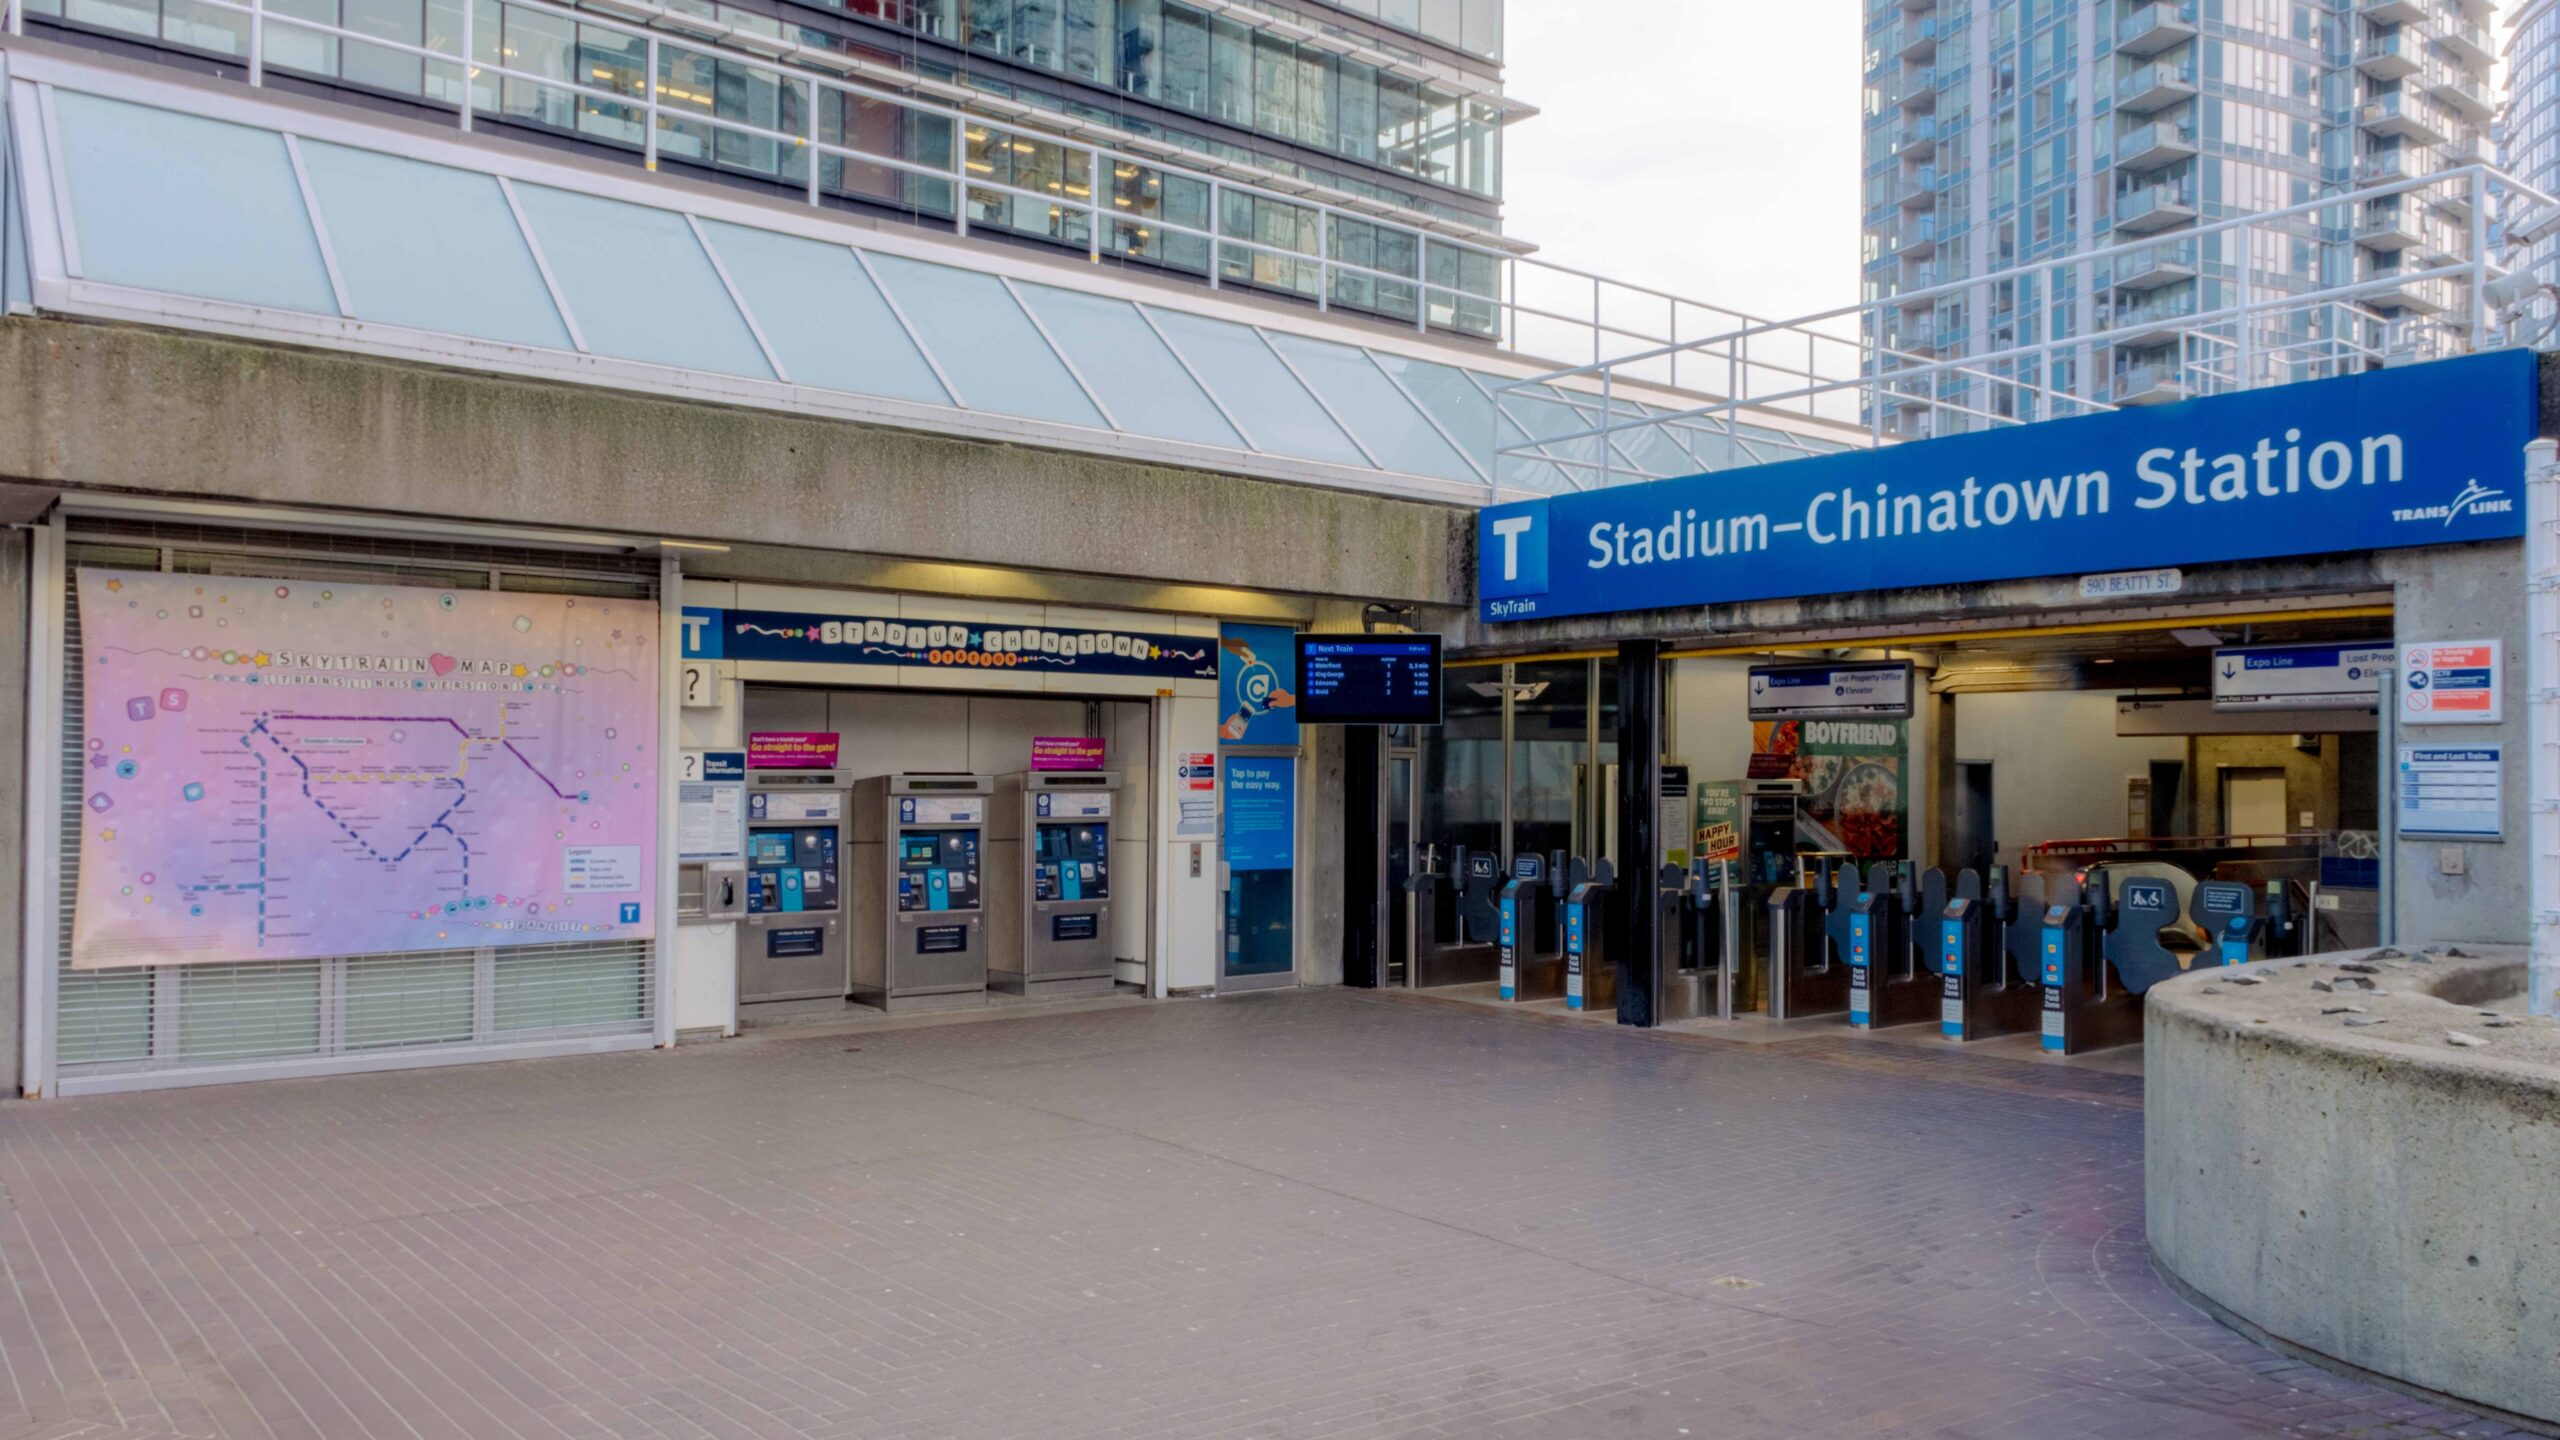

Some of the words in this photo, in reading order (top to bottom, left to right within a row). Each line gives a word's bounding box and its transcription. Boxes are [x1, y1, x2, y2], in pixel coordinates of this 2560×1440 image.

[2134, 427, 2403, 509] Station
[2392, 505, 2450, 521] TRANS
[2469, 499, 2512, 515] LINK
[1493, 515, 1532, 581] T
[2086, 578, 2106, 593] 590
[2109, 575, 2152, 592] BEATTY
[2157, 573, 2174, 589] ST.
[1490, 598, 1536, 618] SkyTrain
[682, 615, 710, 651] T
[828, 626, 965, 644] STADIUM
[990, 635, 1146, 655] CHINATOWN
[1318, 645, 1334, 653] Next
[1336, 645, 1353, 653] Train
[280, 652, 427, 672] SKYTRAIN
[461, 660, 509, 673] MAP
[931, 650, 1017, 665] STATION
[2246, 658, 2271, 668] Expo
[2273, 657, 2294, 666] Line
[2347, 654, 2368, 664] Lost
[2371, 653, 2394, 664] Prop
[1770, 678, 1786, 687] Expo
[1834, 675, 1849, 683] Lost
[1850, 674, 1880, 683] Property
[134, 702, 146, 716] T
[168, 693, 179, 705] S
[1805, 721, 1897, 746] BOYFRIEND
[751, 743, 762, 752] Go
[763, 743, 793, 753] straight
[793, 744, 802, 752] to
[802, 743, 816, 752] the
[816, 743, 836, 753] gate!
[1034, 746, 1044, 754] Go
[1044, 747, 1068, 756] straight
[2415, 752, 2432, 760] First
[2432, 752, 2448, 760] and
[2448, 752, 2466, 760] Last
[2466, 752, 2491, 760] Trains
[705, 759, 728, 768] Transit
[706, 766, 743, 775] Information
[1231, 768, 1245, 779] Tap
[1246, 769, 1255, 778] to
[1256, 770, 1270, 780] pay
[1231, 780, 1244, 789] the
[1245, 781, 1263, 791] easy
[1264, 782, 1281, 791] way.
[1705, 788, 1731, 797] YOU'RE
[1715, 797, 1737, 807] STOPS
[1706, 807, 1728, 815] AWAY!
[1699, 823, 1730, 842] HAPPY
[1710, 835, 1735, 852] HOUR
[624, 905, 637, 921] T
